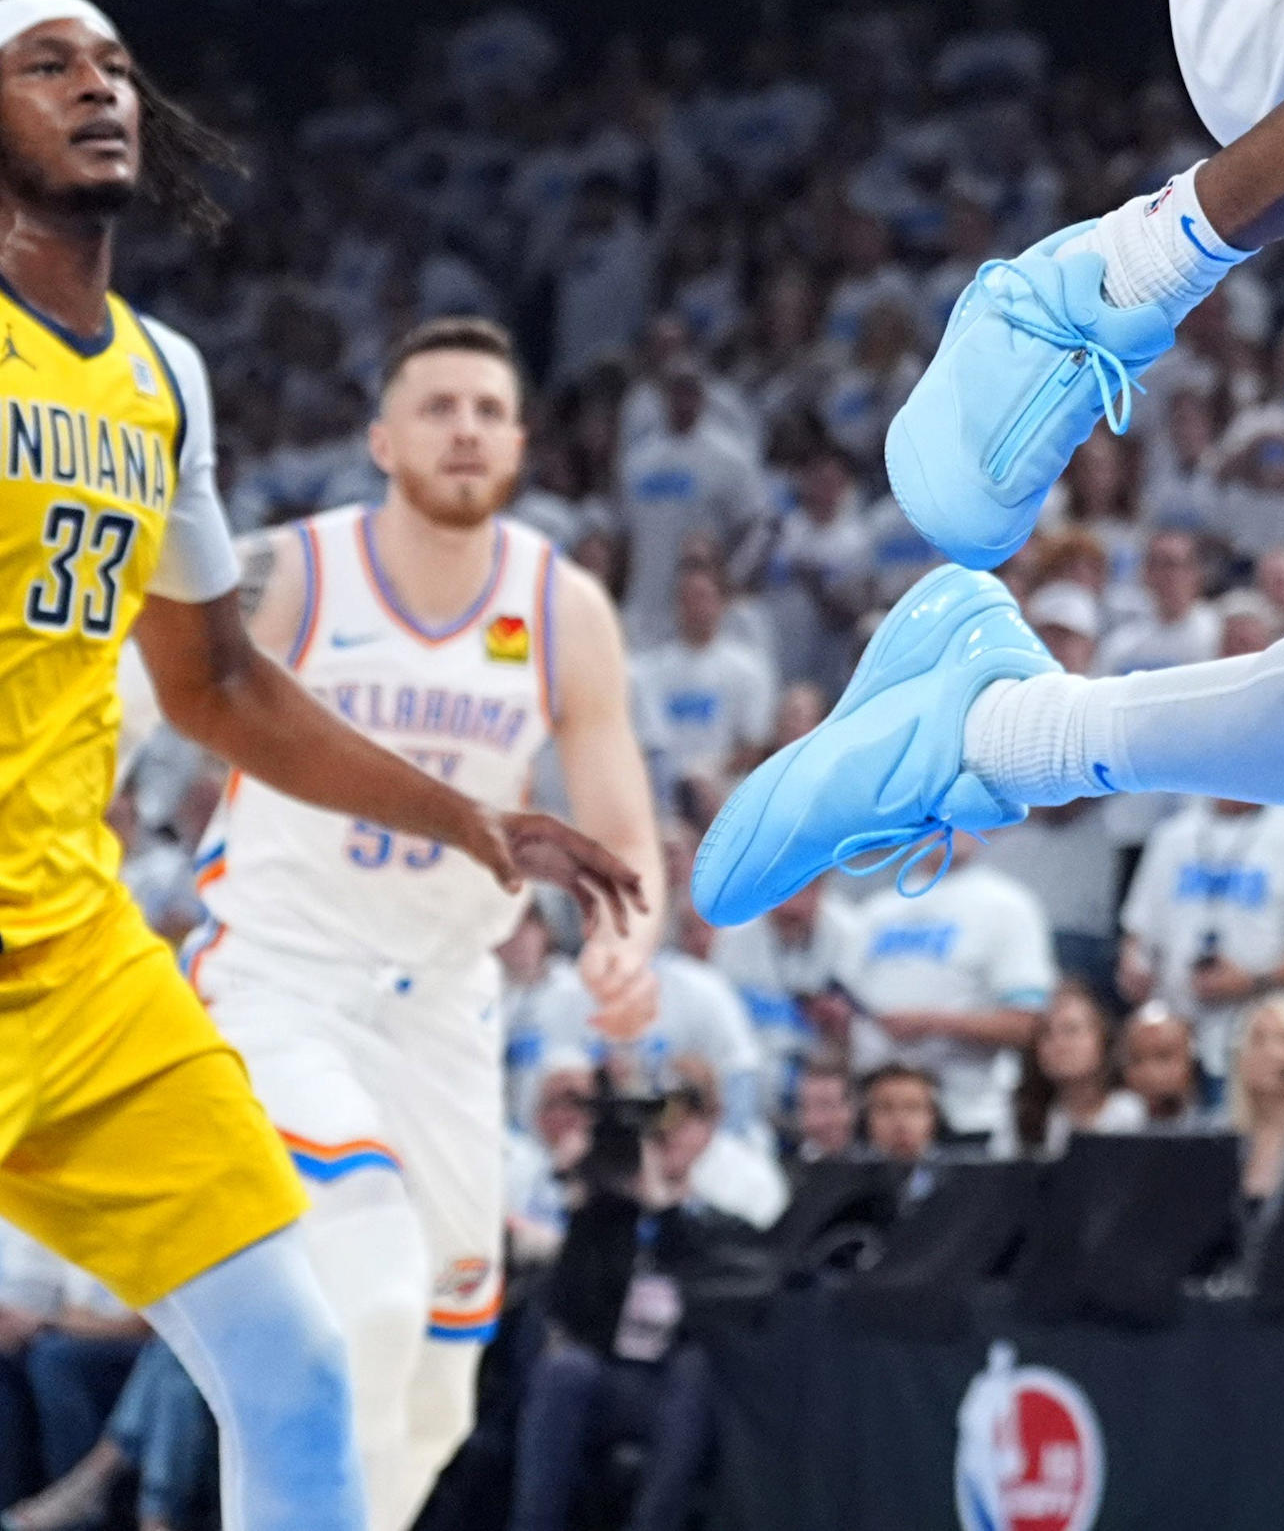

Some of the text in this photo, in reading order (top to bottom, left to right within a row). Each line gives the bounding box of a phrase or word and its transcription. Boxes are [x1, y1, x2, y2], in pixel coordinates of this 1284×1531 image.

[0, 396, 168, 513] NDIANA
[25, 501, 139, 641] 33
[312, 679, 528, 757] KLAHOMA
